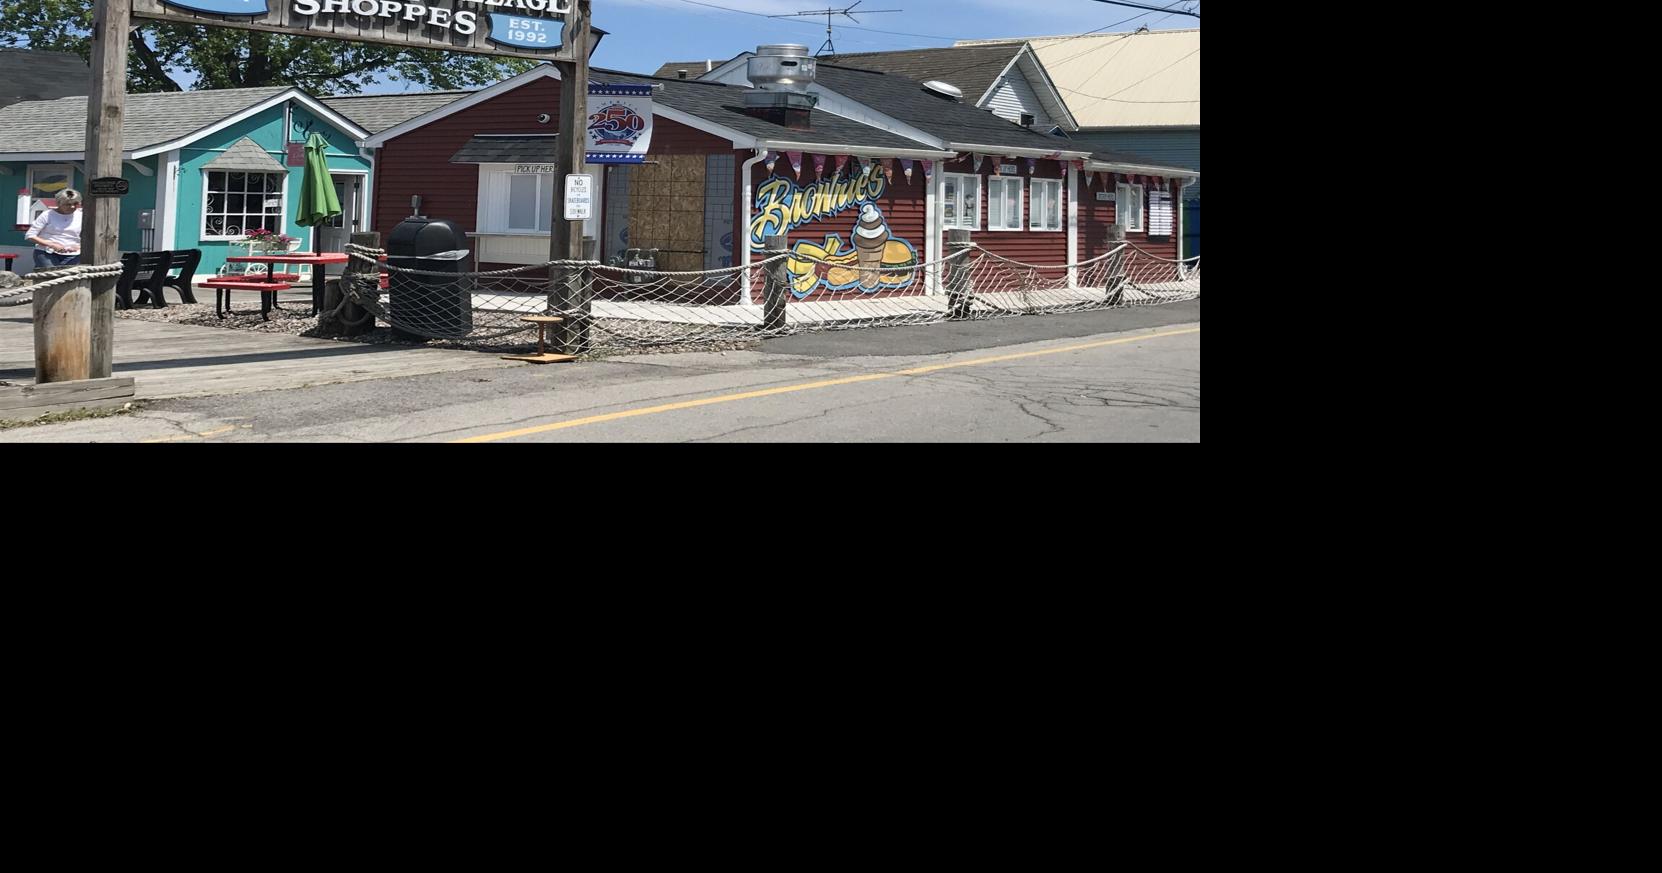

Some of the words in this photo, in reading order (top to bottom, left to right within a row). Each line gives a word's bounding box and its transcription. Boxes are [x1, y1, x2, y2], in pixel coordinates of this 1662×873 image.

[294, 0, 477, 35] SHOPPES
[509, 18, 545, 31] EST.
[507, 30, 547, 43] 1992
[587, 107, 645, 131] 250
[516, 165, 530, 173] PICK
[531, 165, 541, 173] UP
[541, 165, 554, 173] HER
